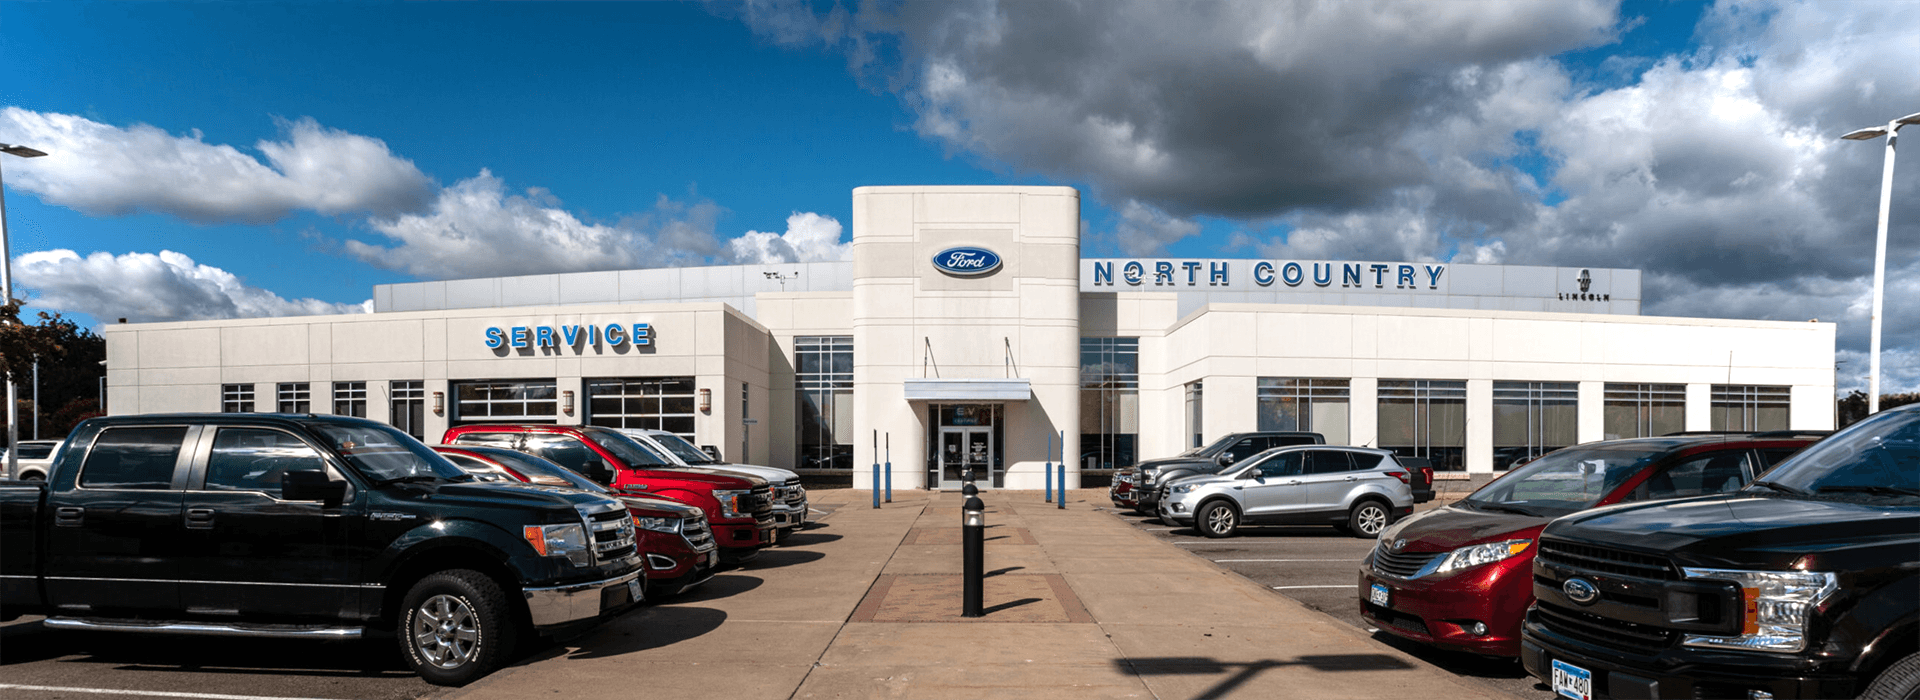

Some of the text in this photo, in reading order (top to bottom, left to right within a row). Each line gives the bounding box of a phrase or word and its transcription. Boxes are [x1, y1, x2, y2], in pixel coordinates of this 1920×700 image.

[946, 251, 986, 268] Ford
[1093, 260, 1444, 287] NORTH COUNTRY
[1558, 292, 1610, 302] LINCOLN
[485, 323, 651, 348] SERVICE
[1573, 676, 1589, 695] 480
